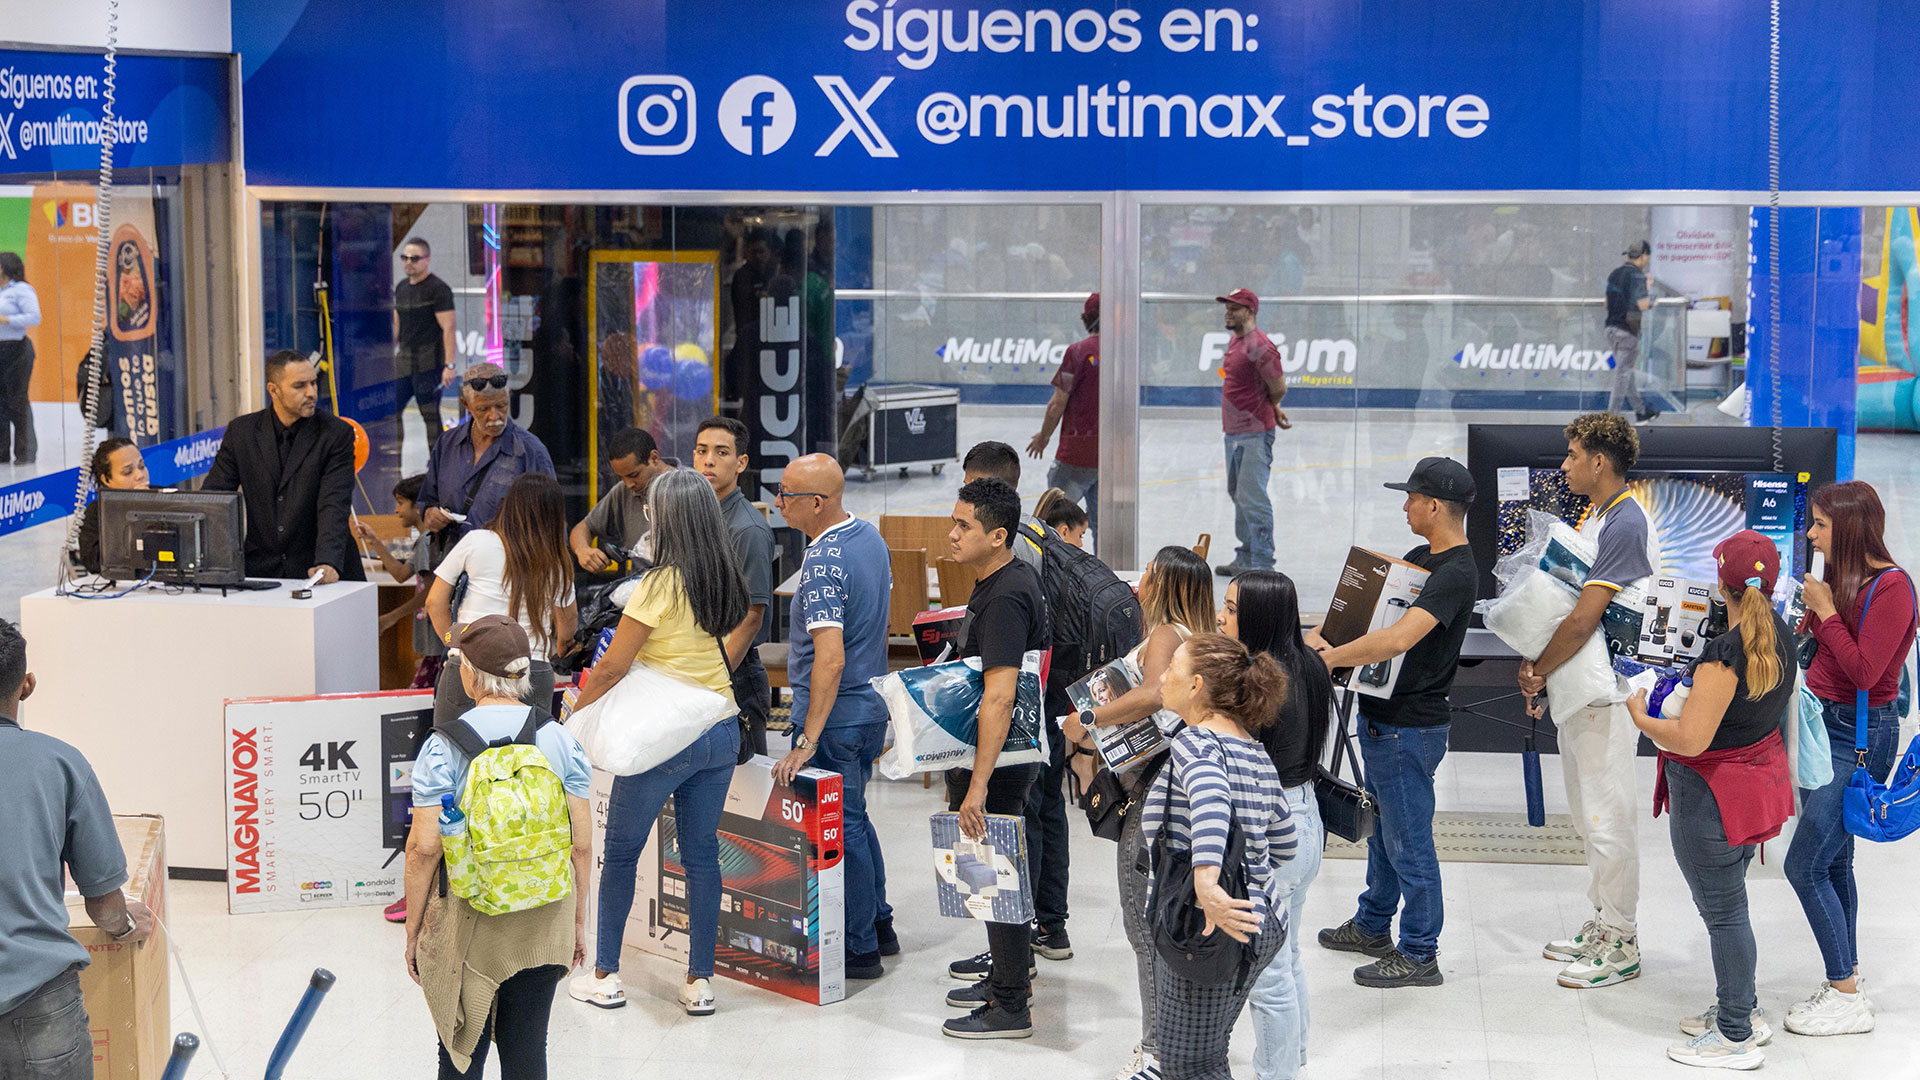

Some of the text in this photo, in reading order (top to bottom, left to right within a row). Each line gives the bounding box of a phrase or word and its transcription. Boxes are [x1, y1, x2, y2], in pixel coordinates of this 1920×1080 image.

[843, 0, 1259, 71] Síguenos en:
[0, 66, 98, 109] Síguenos en:
[916, 79, 1490, 145] @multimax_store
[943, 337, 1067, 365] MultiMa
[1459, 342, 1614, 371] MultiMax
[1286, 375, 1353, 387] perMayorista
[1753, 480, 1788, 489] Hisense
[1762, 498, 1777, 508] A6
[1683, 603, 1705, 611] CAFETERA
[300, 741, 359, 772] 4K
[300, 771, 361, 786] SmartTV
[232, 727, 261, 894] MAGNAVOX
[263, 720, 276, 892] SMART. VERY SMART.
[821, 792, 839, 804] JVC
[366, 878, 396, 886] android
